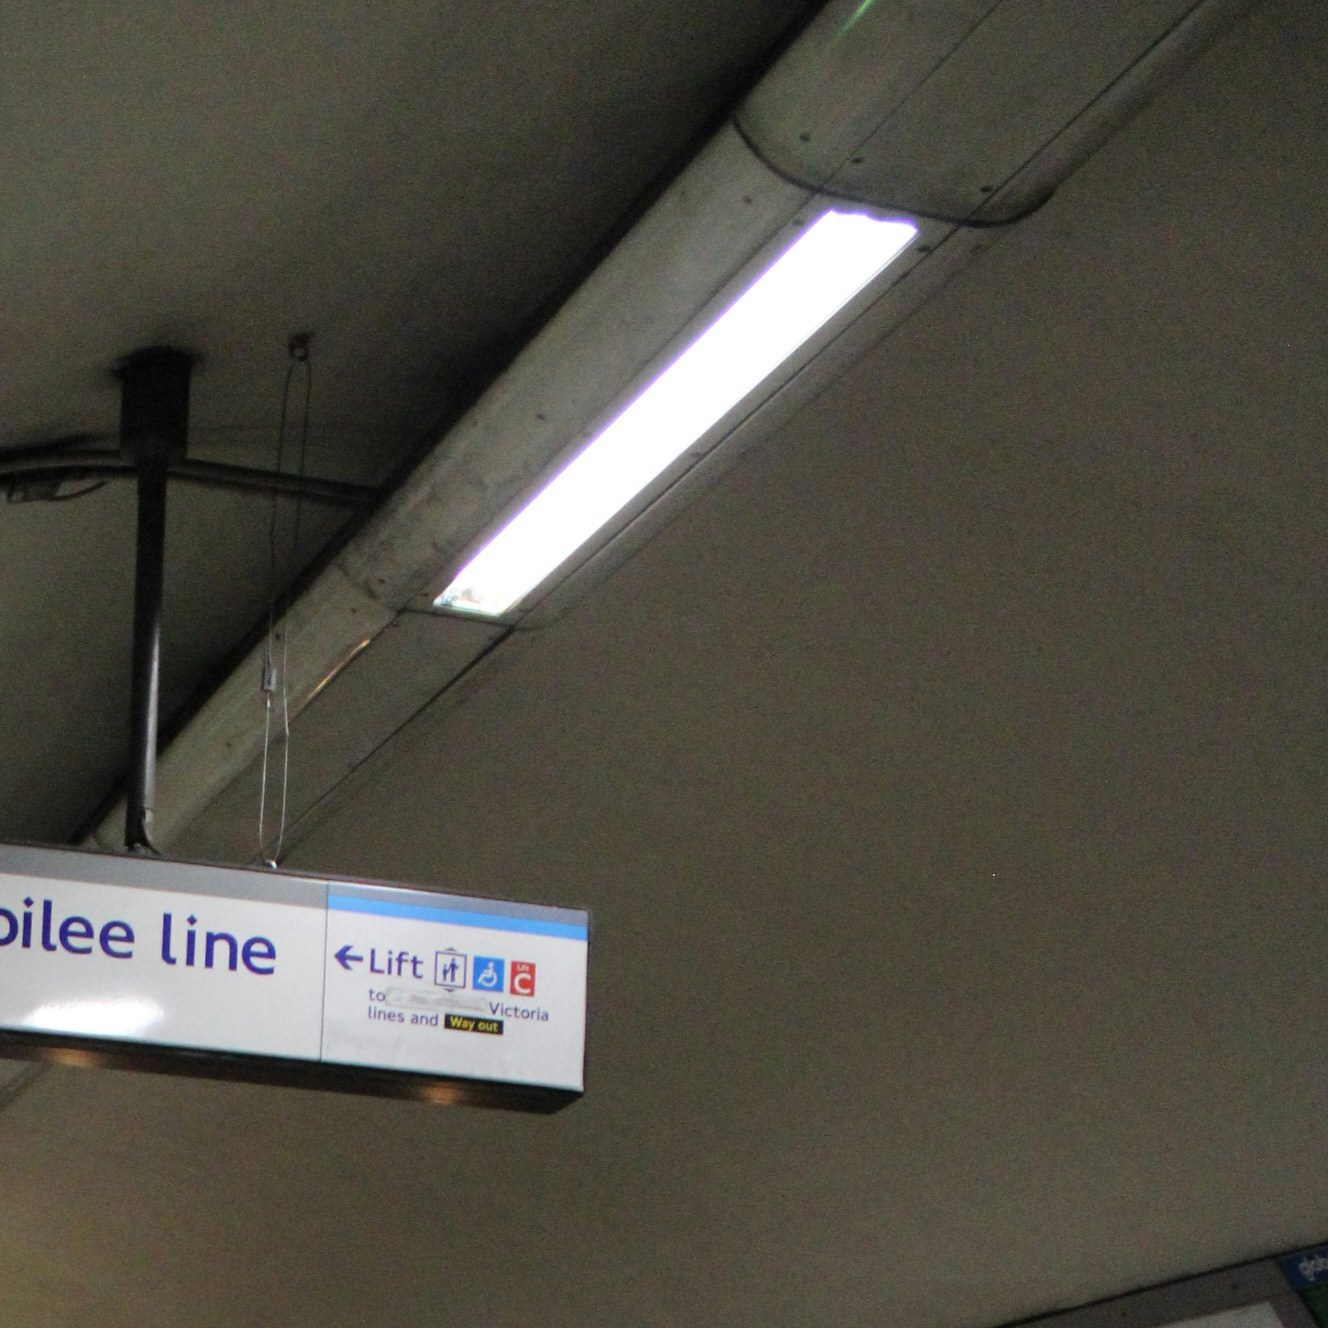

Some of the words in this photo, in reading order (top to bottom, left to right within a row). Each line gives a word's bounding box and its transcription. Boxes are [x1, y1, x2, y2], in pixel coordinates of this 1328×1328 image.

[161, 912, 276, 975] line
[369, 948, 424, 979] Lift
[514, 973, 531, 994] C
[368, 988, 386, 1001] to
[489, 1001, 549, 1021] Victoria
[368, 1006, 404, 1023] lines
[410, 1013, 439, 1027] and
[449, 1016, 474, 1032] Way
[478, 1020, 499, 1033] out
